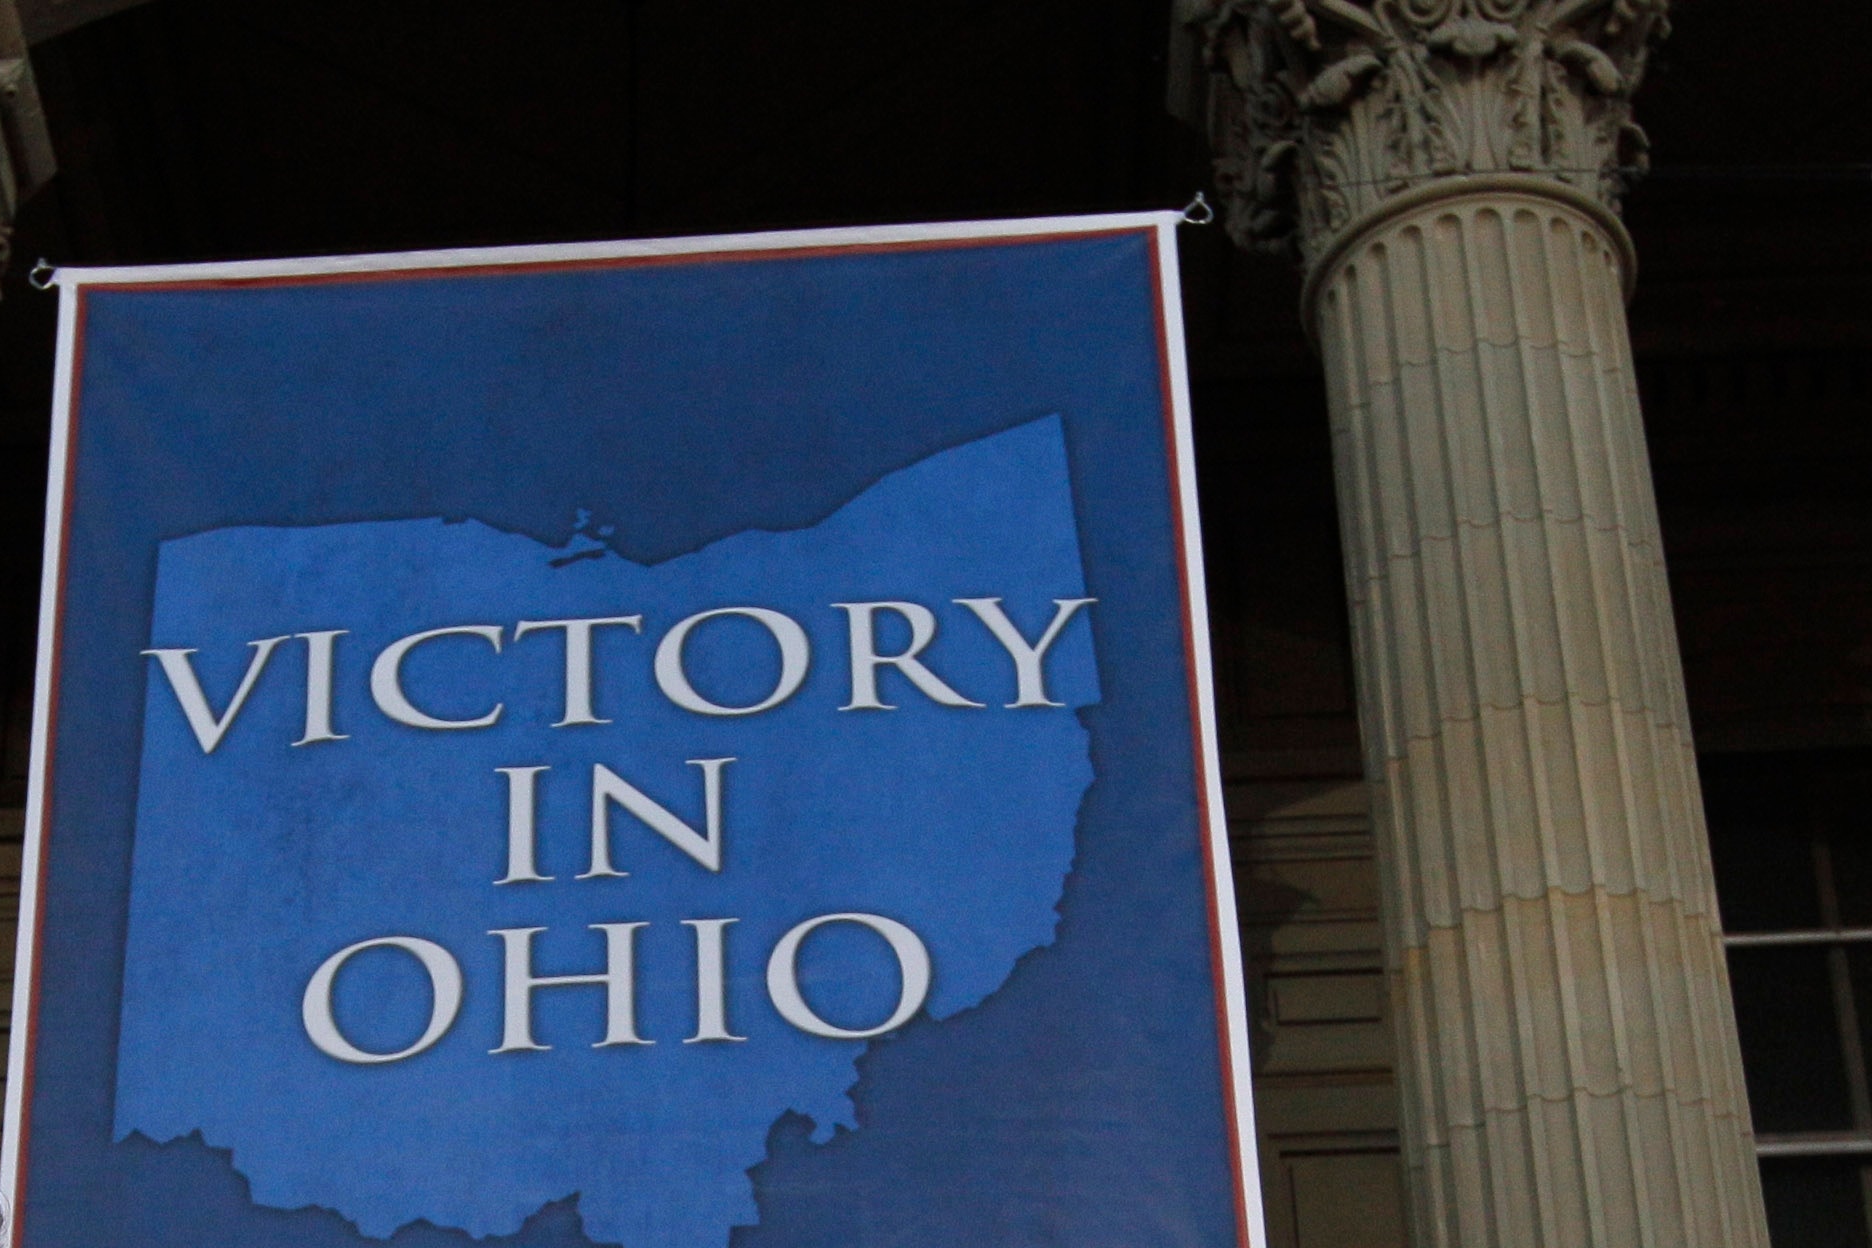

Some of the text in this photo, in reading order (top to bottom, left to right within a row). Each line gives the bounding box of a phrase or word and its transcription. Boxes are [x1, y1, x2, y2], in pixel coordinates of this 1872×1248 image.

[139, 597, 1098, 754] VICTORY
[492, 757, 737, 885] IN
[301, 912, 931, 1064] OHIO
